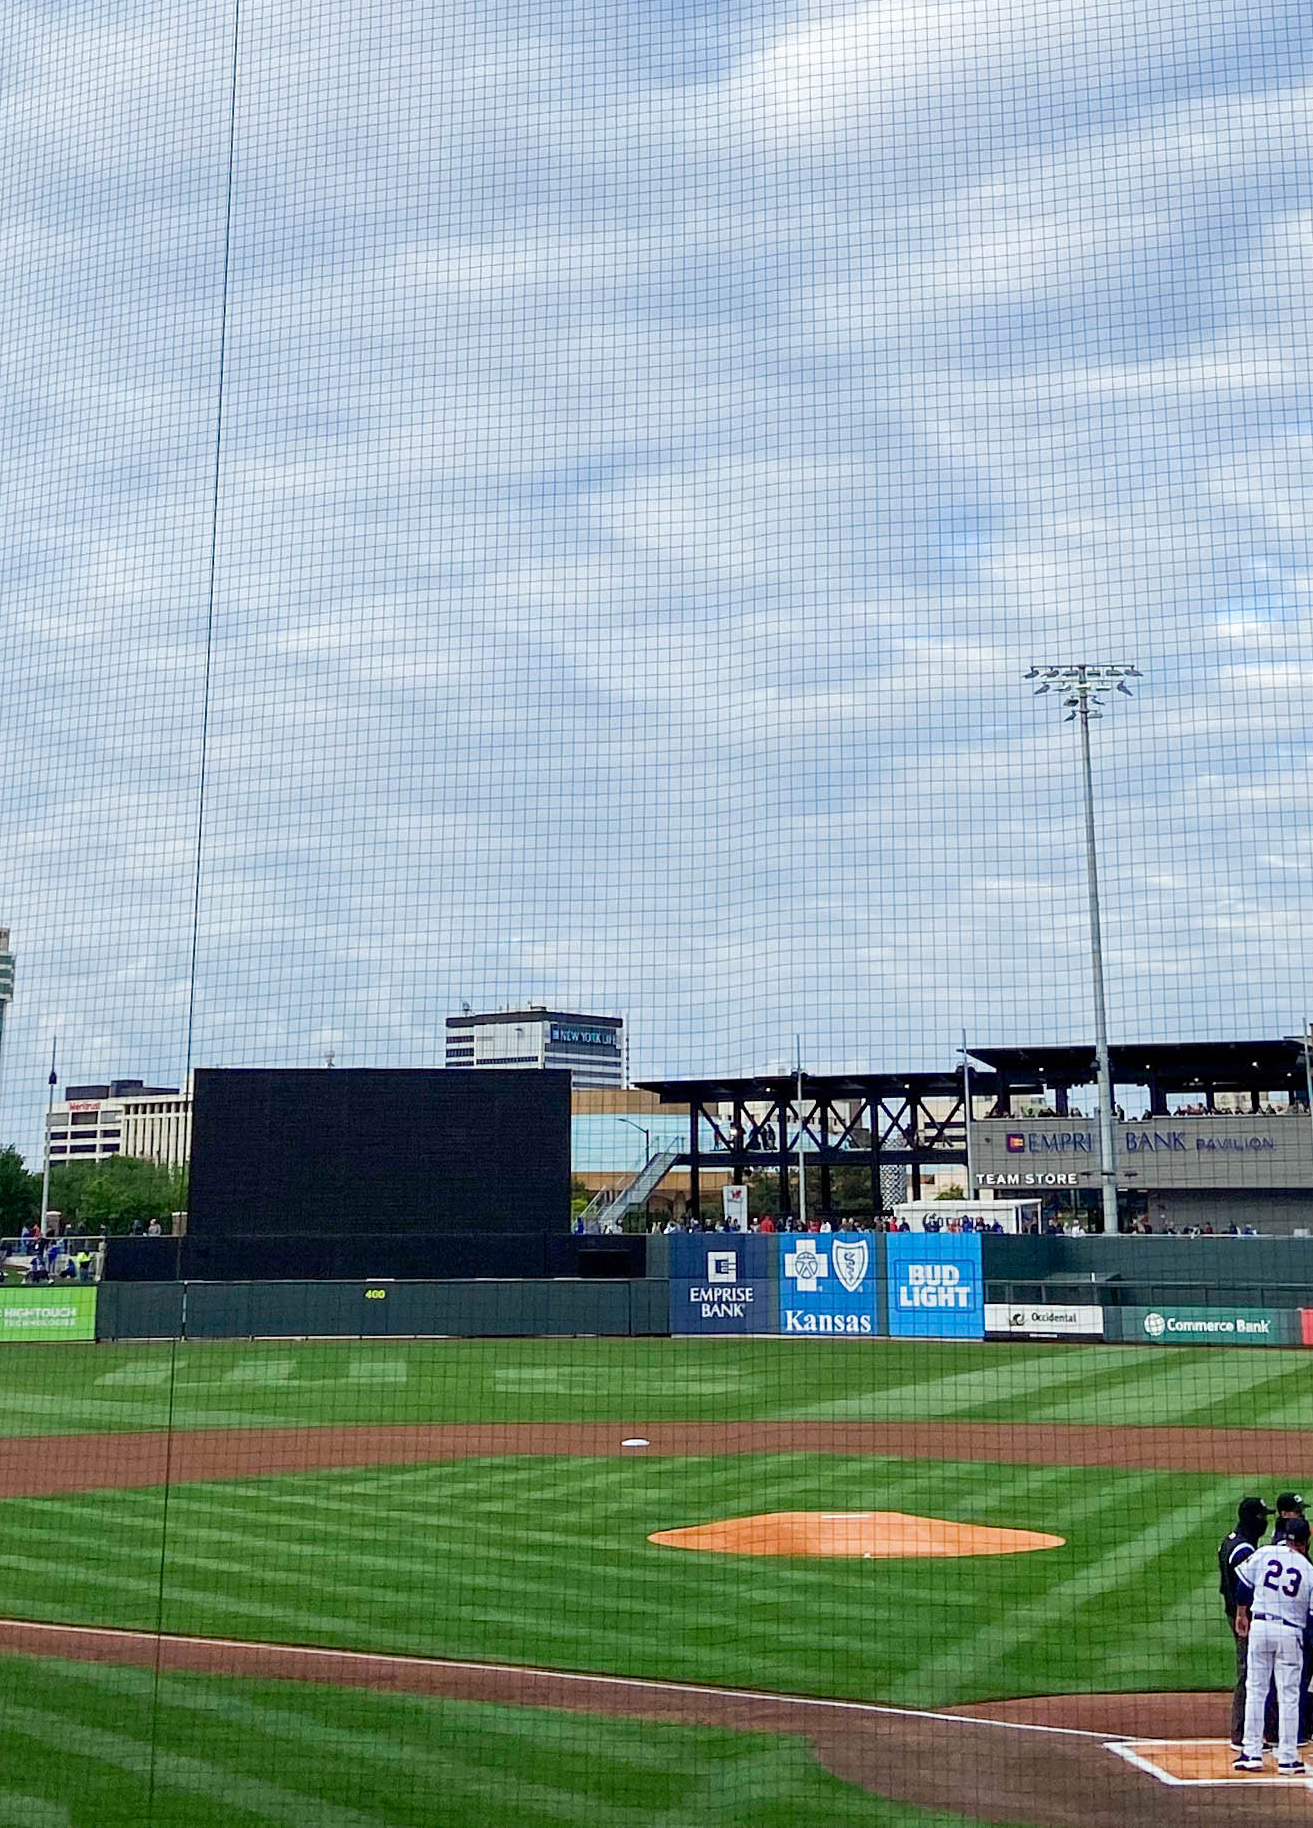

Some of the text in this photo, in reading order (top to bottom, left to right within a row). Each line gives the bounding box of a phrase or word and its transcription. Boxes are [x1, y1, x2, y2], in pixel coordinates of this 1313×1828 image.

[560, 1030, 578, 1041] NEW
[580, 1031, 601, 1043] YORK
[1028, 1131, 1275, 1154] EMPRI BANK PAVILION
[976, 1173, 1078, 1185] TEAM STORE
[908, 1264, 960, 1286] BUD
[365, 1289, 386, 1299] 400
[690, 1287, 754, 1302] EMPRISE
[900, 1286, 971, 1308] LIGHT
[701, 1303, 744, 1318] BANK
[1031, 1312, 1077, 1323] Occidental
[785, 1310, 872, 1333] Kansas
[1167, 1318, 1271, 1334] Commerce Bank
[1263, 1559, 1303, 1598] 23
